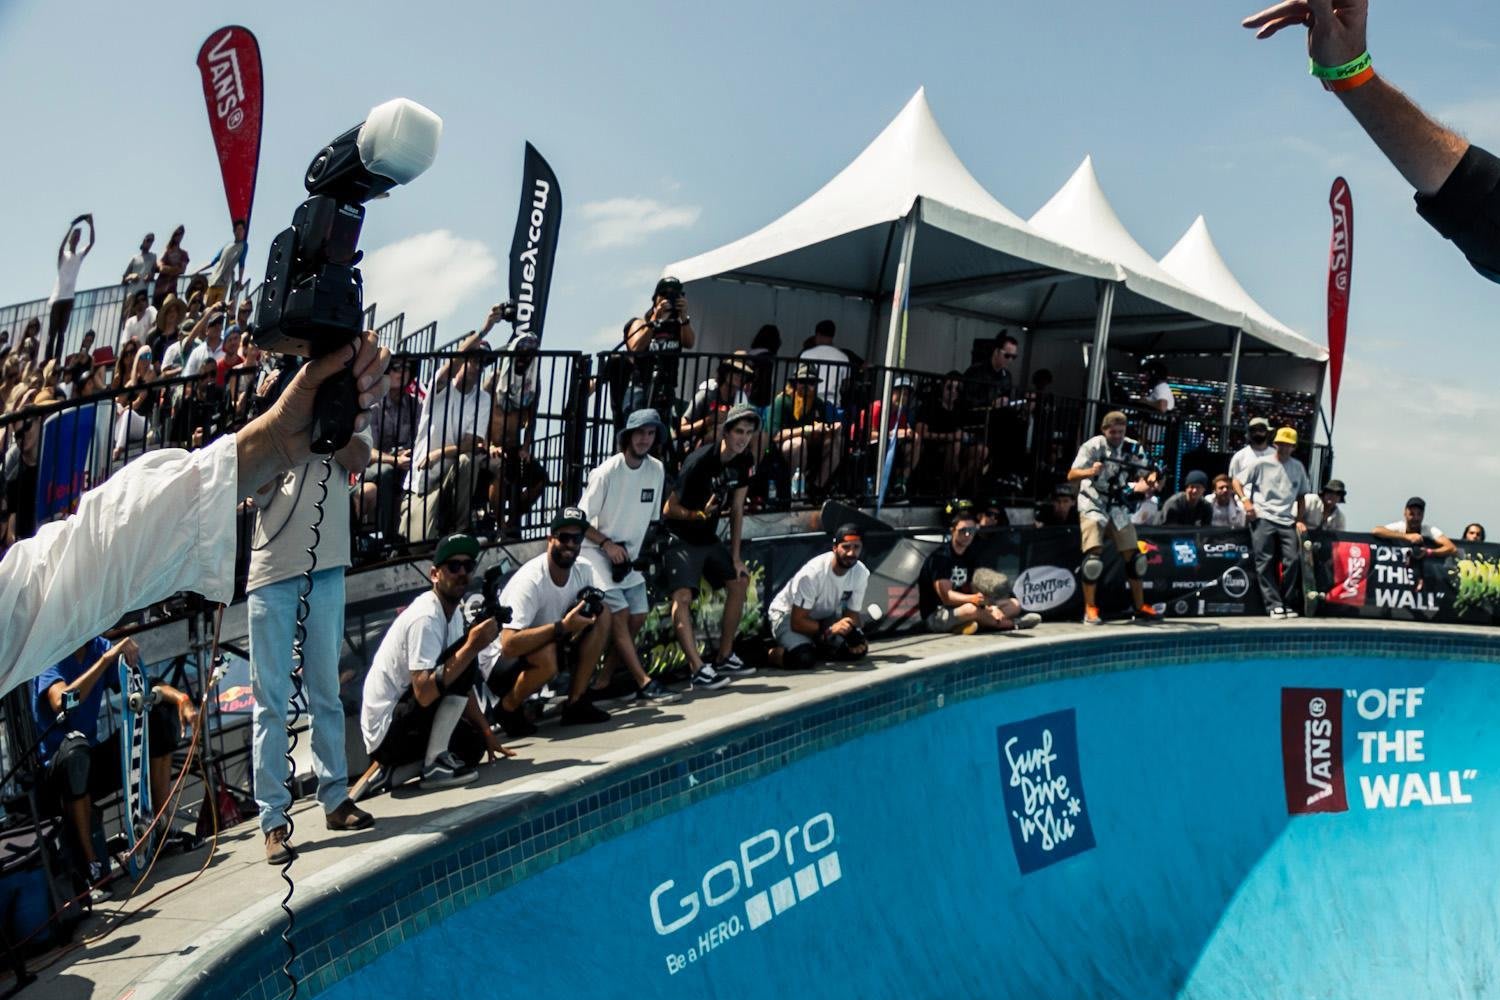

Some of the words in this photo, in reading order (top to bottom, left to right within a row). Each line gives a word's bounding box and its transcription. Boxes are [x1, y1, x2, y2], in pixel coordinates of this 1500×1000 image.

[1374, 564, 1416, 586] THE
[1004, 728, 1058, 787] Surf
[1357, 729, 1426, 764] THE
[1020, 774, 1070, 816] Dive
[649, 811, 836, 936] GoPro
[665, 953, 687, 975] Be
[688, 947, 698, 963] a
